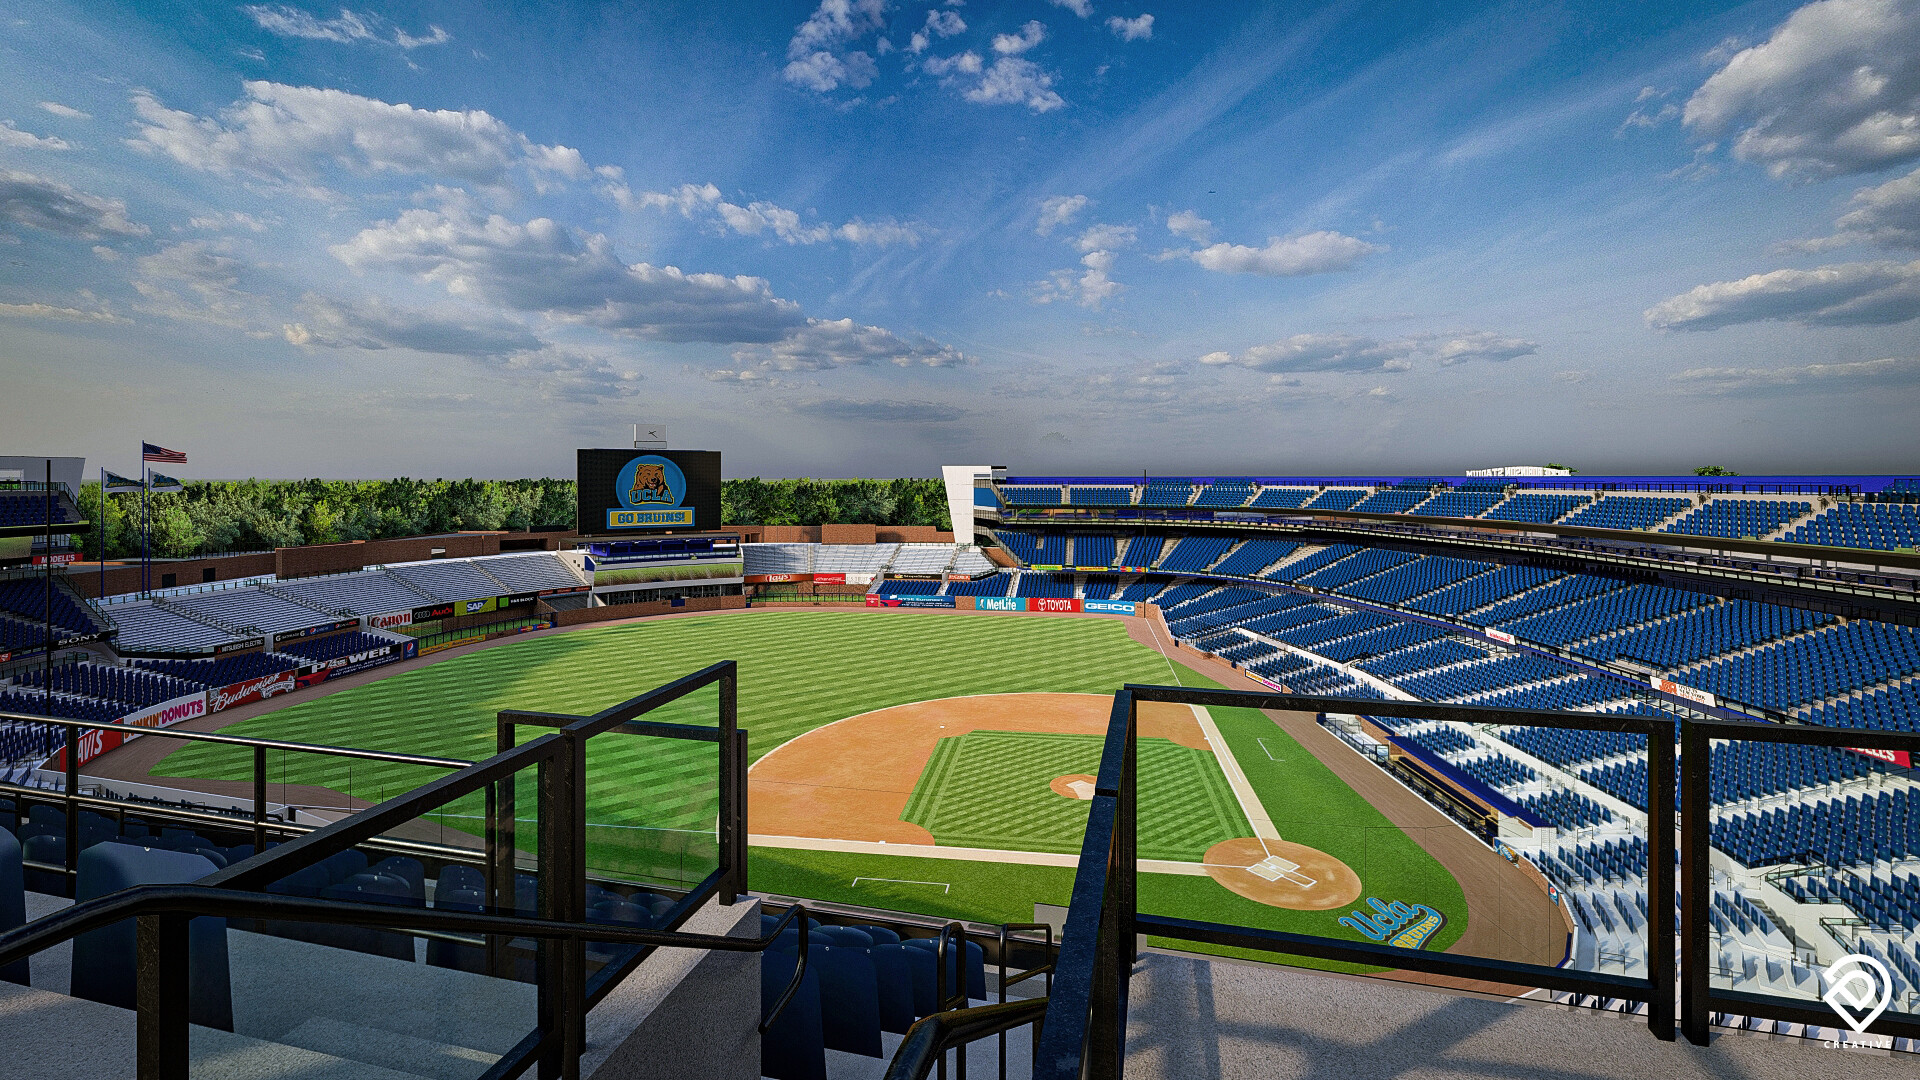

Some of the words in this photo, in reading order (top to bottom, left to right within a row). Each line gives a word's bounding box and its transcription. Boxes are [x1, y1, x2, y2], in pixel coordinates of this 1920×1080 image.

[631, 489, 672, 503] UCLA
[618, 513, 634, 524] GO
[636, 512, 685, 523] BRUINS!
[467, 603, 483, 611] SAP
[987, 598, 1016, 610] MetLife
[1047, 600, 1071, 610] TOYOTA
[1085, 602, 1134, 612] GEICO
[371, 613, 410, 628] Canon
[57, 633, 100, 645] SONY
[209, 672, 280, 712] Budweiser
[162, 699, 203, 724] DONUTS
[78, 730, 104, 763] AVIS
